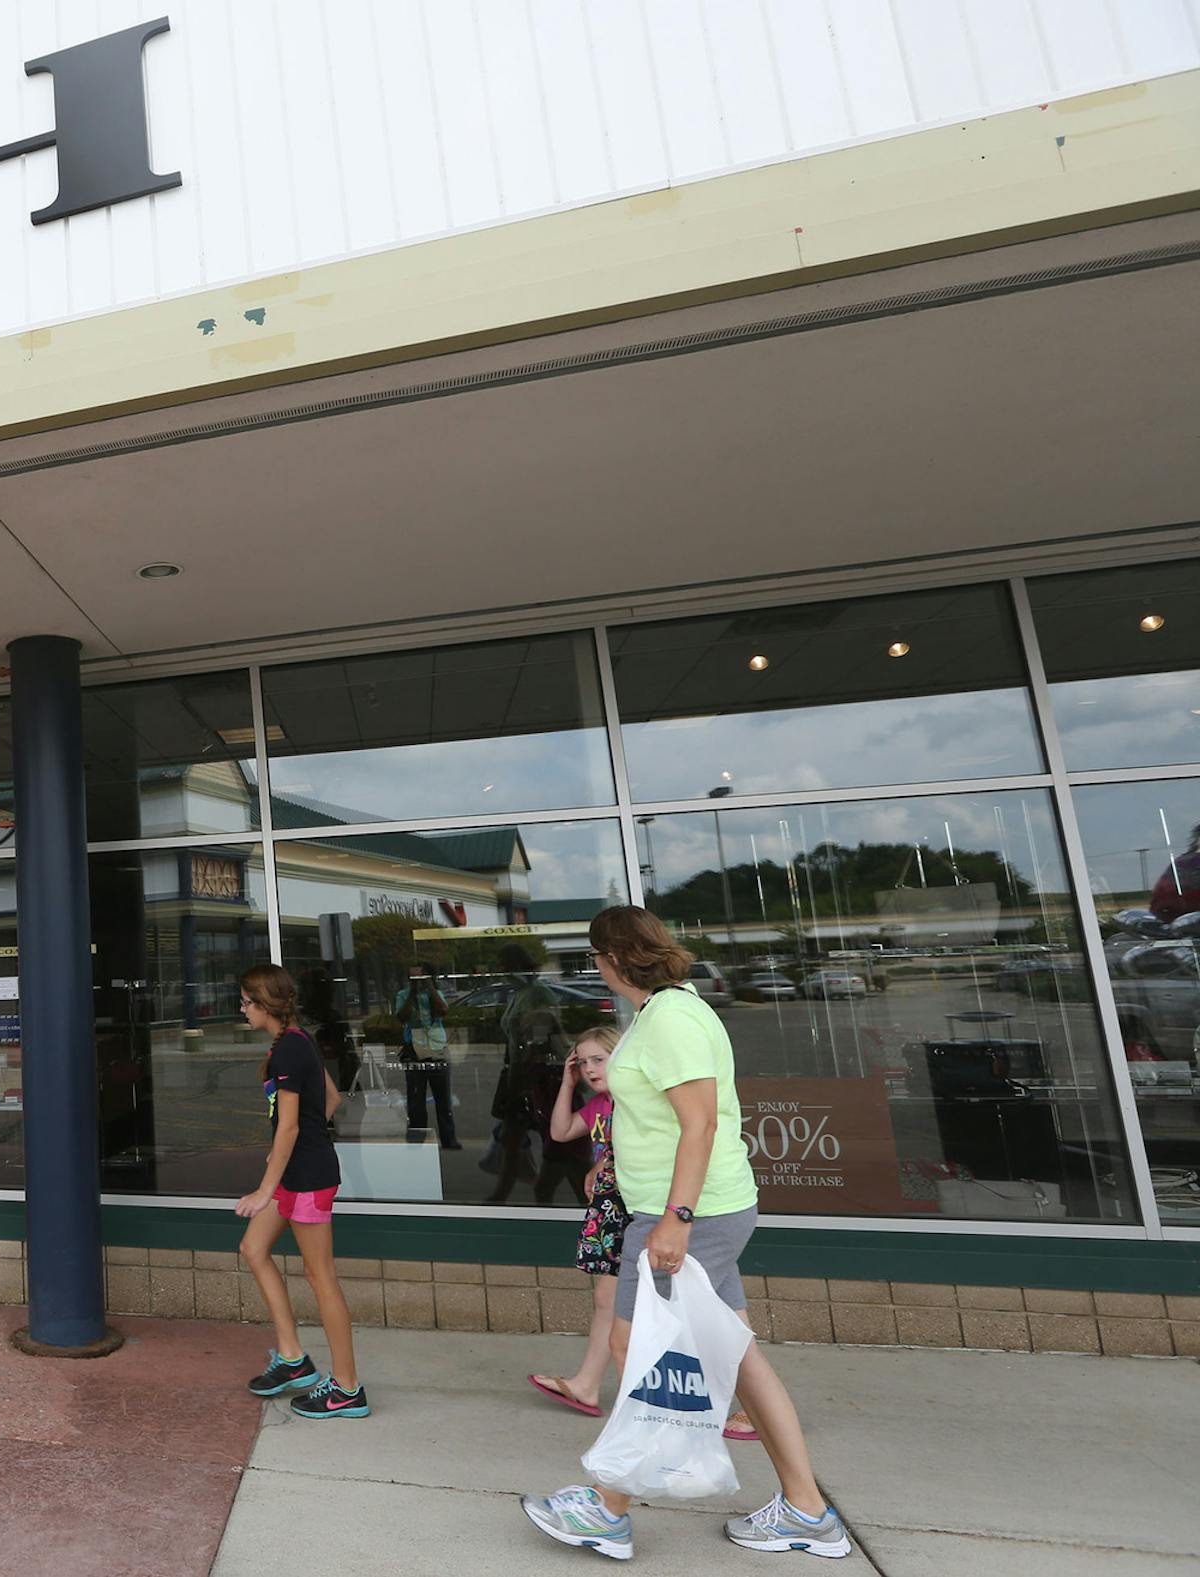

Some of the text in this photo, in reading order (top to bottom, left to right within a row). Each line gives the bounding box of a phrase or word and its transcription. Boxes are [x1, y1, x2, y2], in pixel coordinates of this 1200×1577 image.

[757, 1102, 800, 1113] ENJOY
[772, 1163, 801, 1174] OFF
[773, 1175, 844, 1187] PURCHASE
